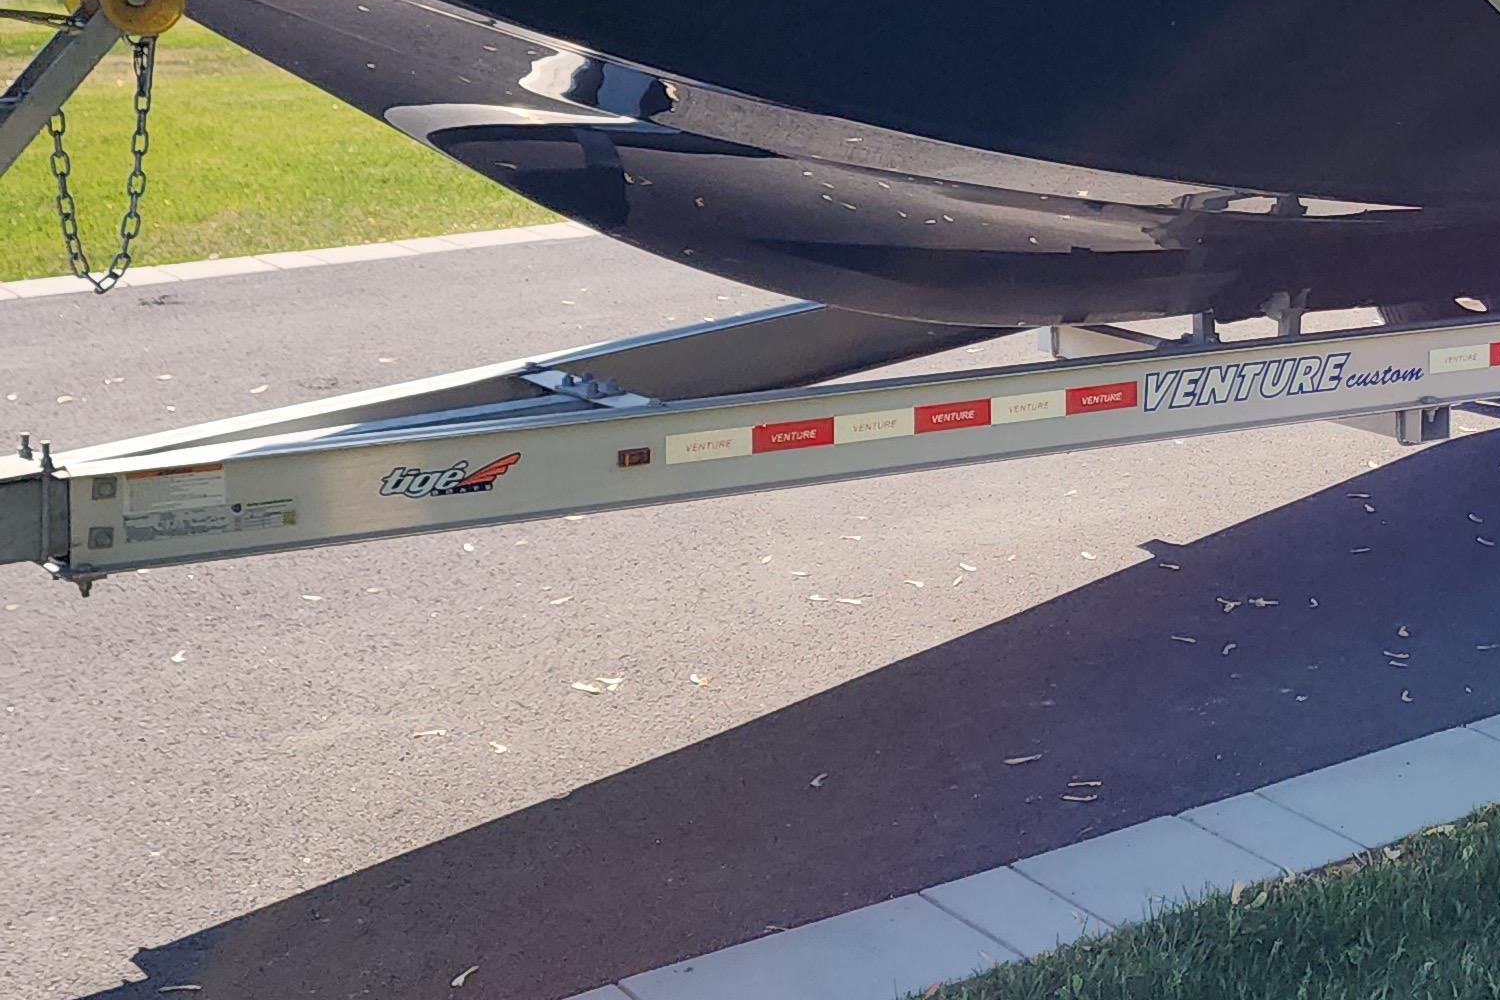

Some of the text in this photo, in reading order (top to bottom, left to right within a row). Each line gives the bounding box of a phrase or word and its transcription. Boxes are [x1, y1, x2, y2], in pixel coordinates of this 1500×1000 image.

[1444, 352, 1478, 365] VENTURE
[1143, 351, 1424, 412] VENTURE custom
[1081, 391, 1123, 406] VENTURE
[1009, 401, 1049, 414] VENTURE
[931, 409, 976, 424] VENTURE
[852, 419, 897, 433] VENTURE
[771, 428, 818, 443] VENTURE
[686, 439, 732, 452] VENTURE
[379, 459, 468, 498] tigé
